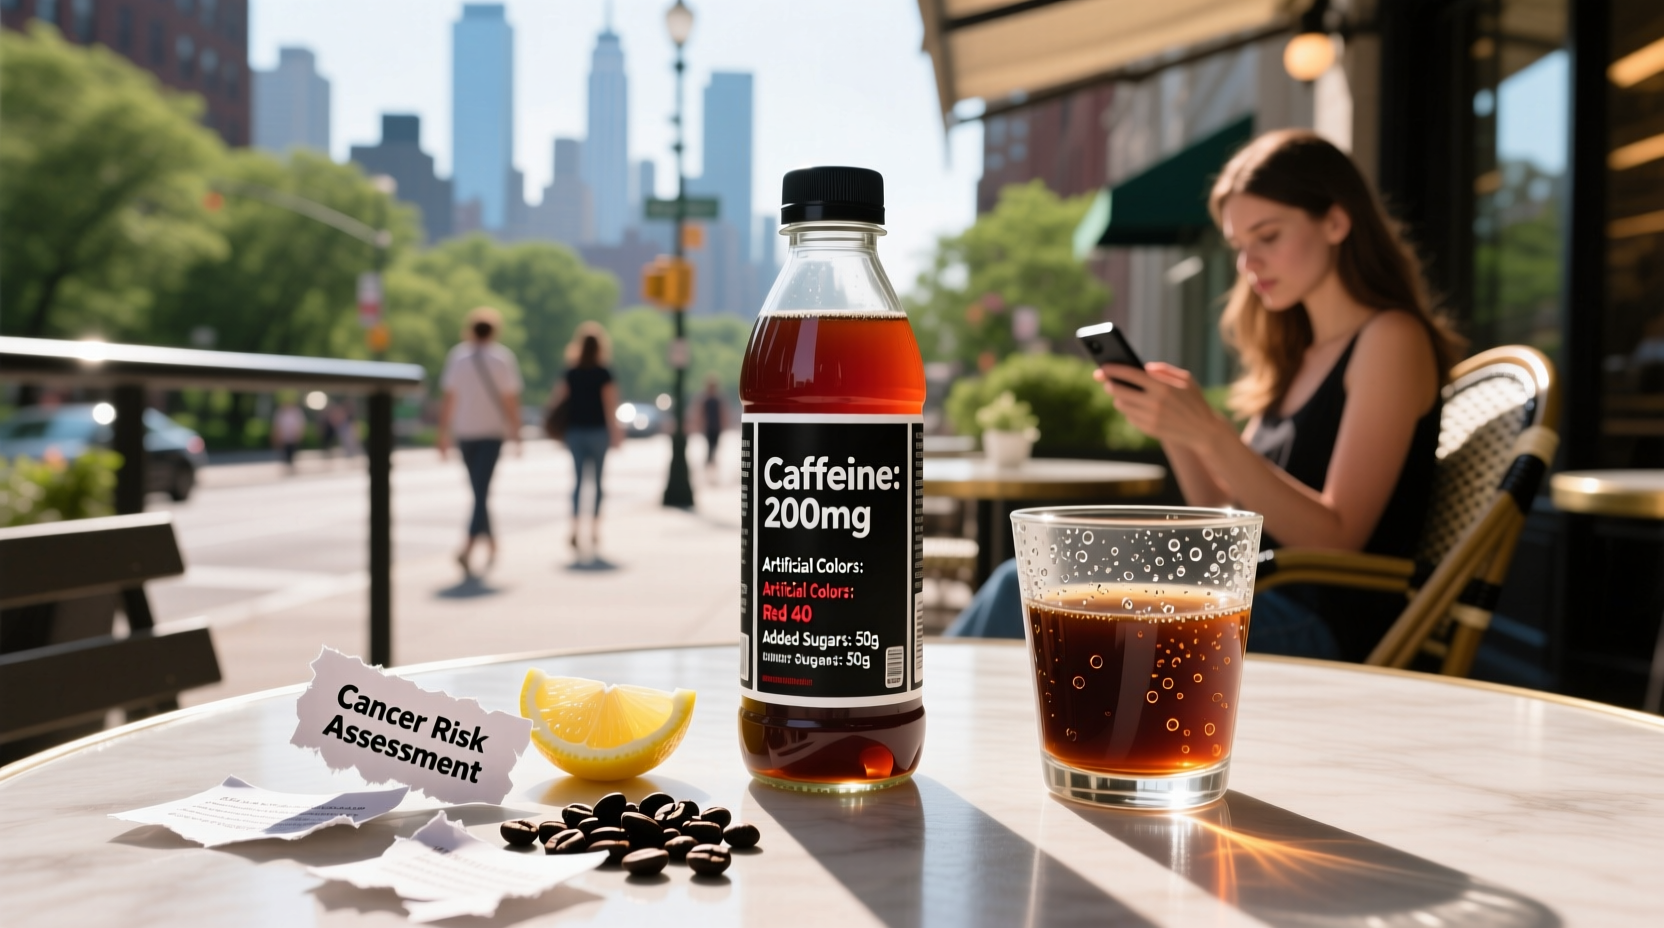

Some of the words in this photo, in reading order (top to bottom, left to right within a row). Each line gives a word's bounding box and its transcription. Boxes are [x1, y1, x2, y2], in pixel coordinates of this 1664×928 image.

[763, 455, 900, 491] Caffeine:
[764, 496, 871, 539] 200mg
[816, 557, 864, 574] Colors:
[763, 603, 788, 623] Red
[790, 604, 813, 623] 40
[762, 628, 800, 646] Added
[802, 631, 852, 651] Sugars:
[855, 630, 880, 650] 50g
[845, 651, 871, 670] 50g
[337, 684, 428, 733] Cancer
[430, 715, 491, 754] Risk
[322, 714, 485, 784] Assessment
